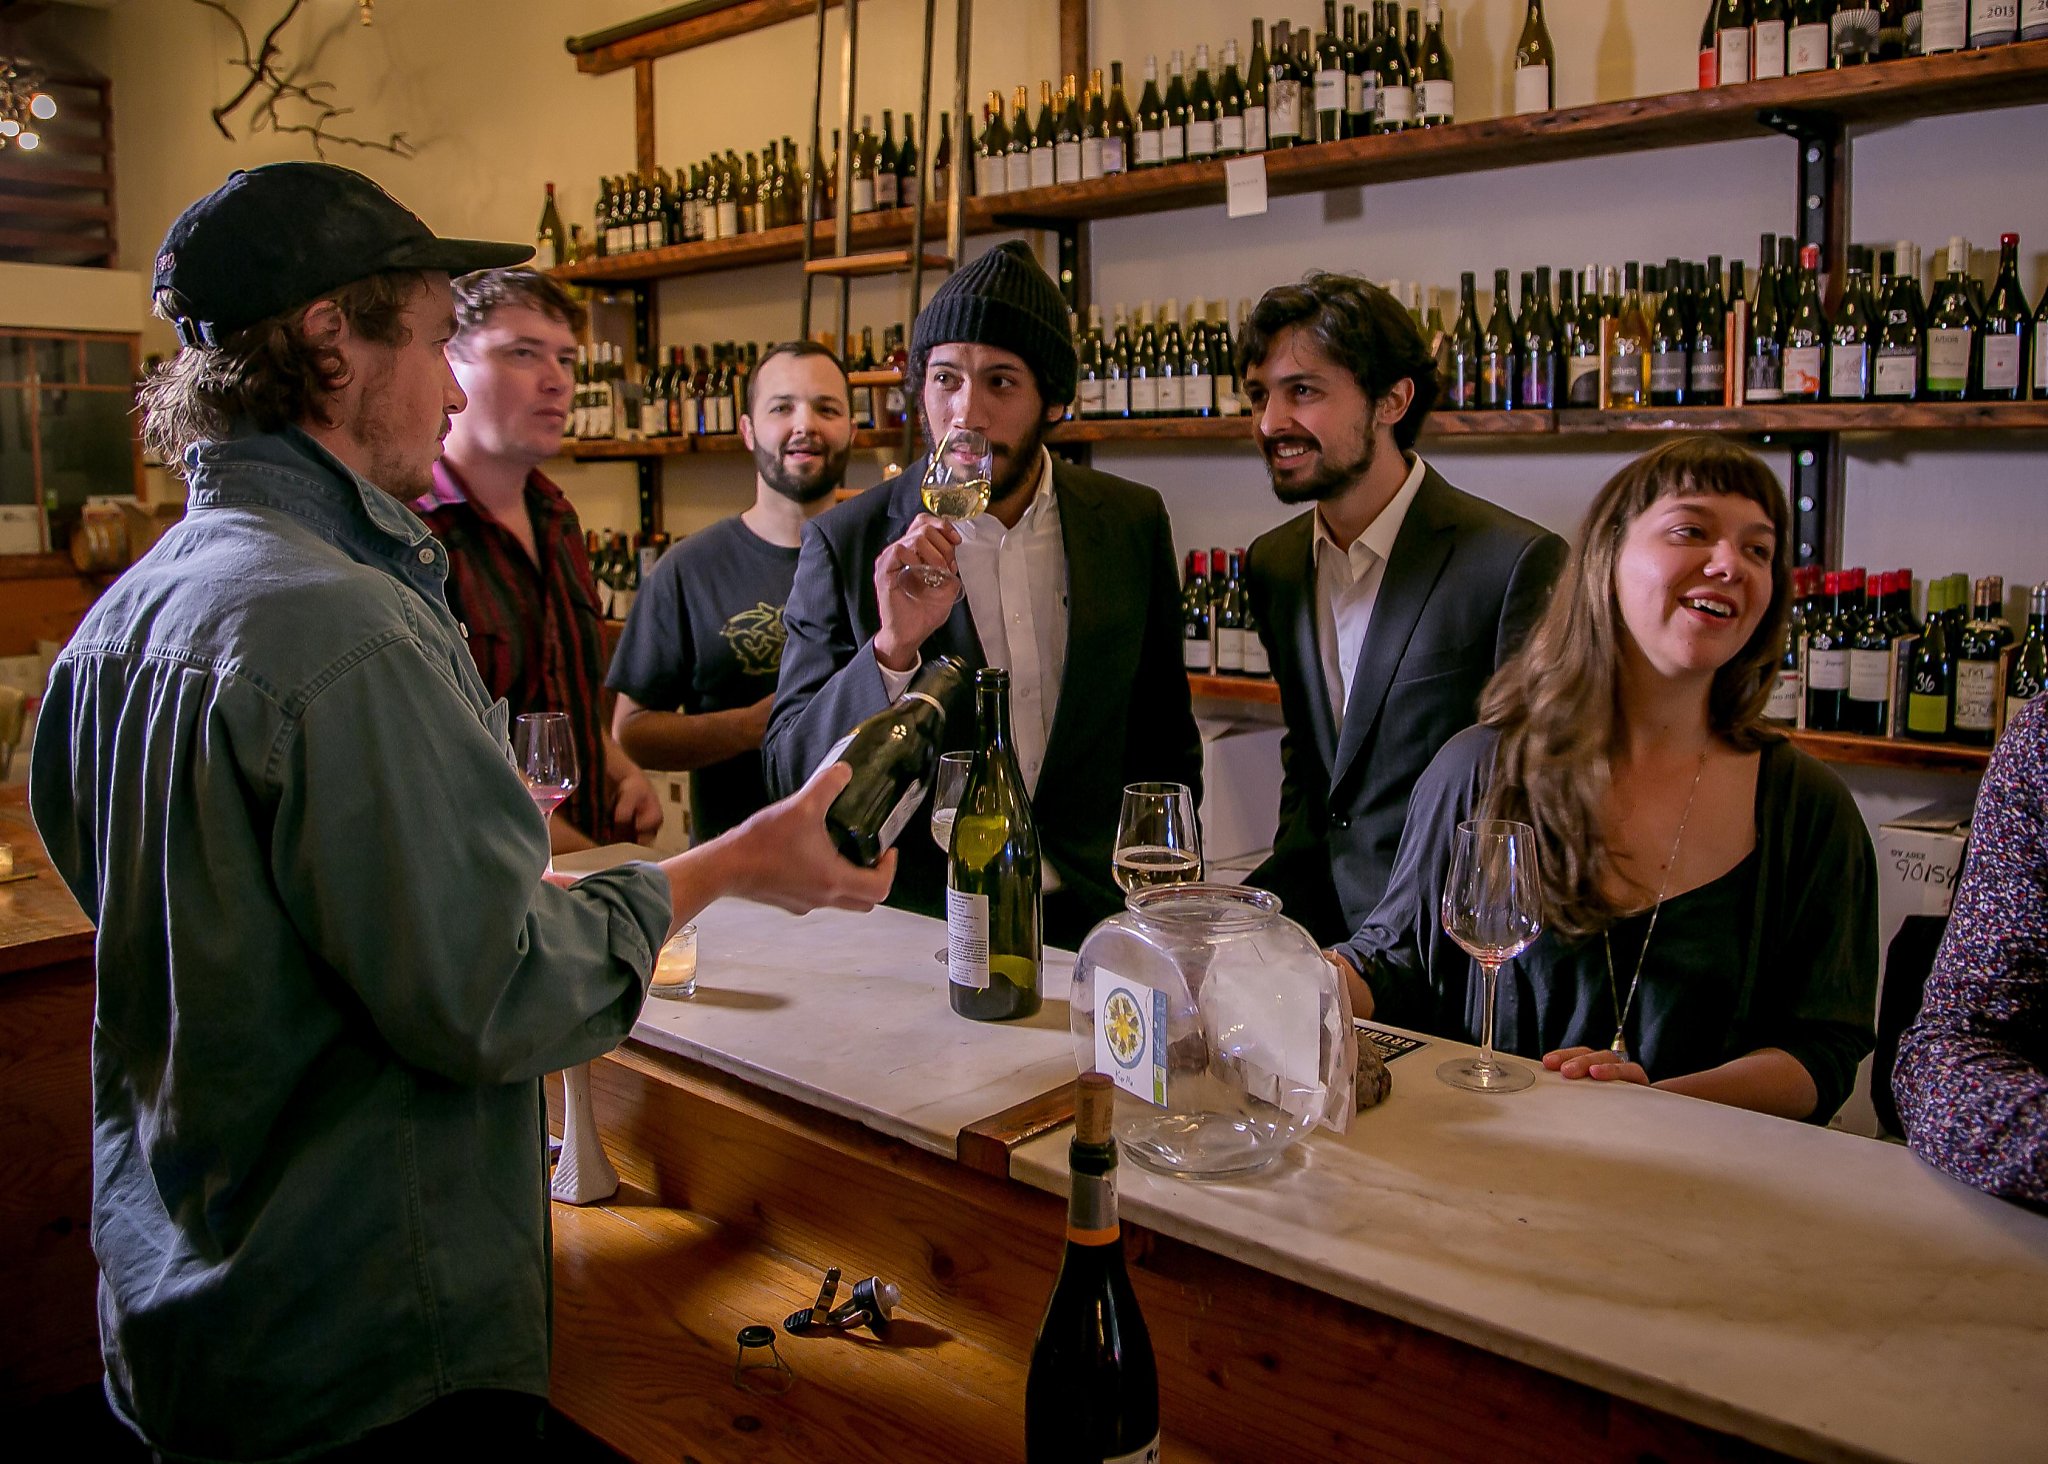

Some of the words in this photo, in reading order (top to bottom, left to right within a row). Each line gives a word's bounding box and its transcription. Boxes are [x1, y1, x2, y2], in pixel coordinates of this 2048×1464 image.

[1916, 672, 1936, 693] 36
[2016, 677, 2039, 697] 33
[1355, 1026, 1417, 1049] BRUM
